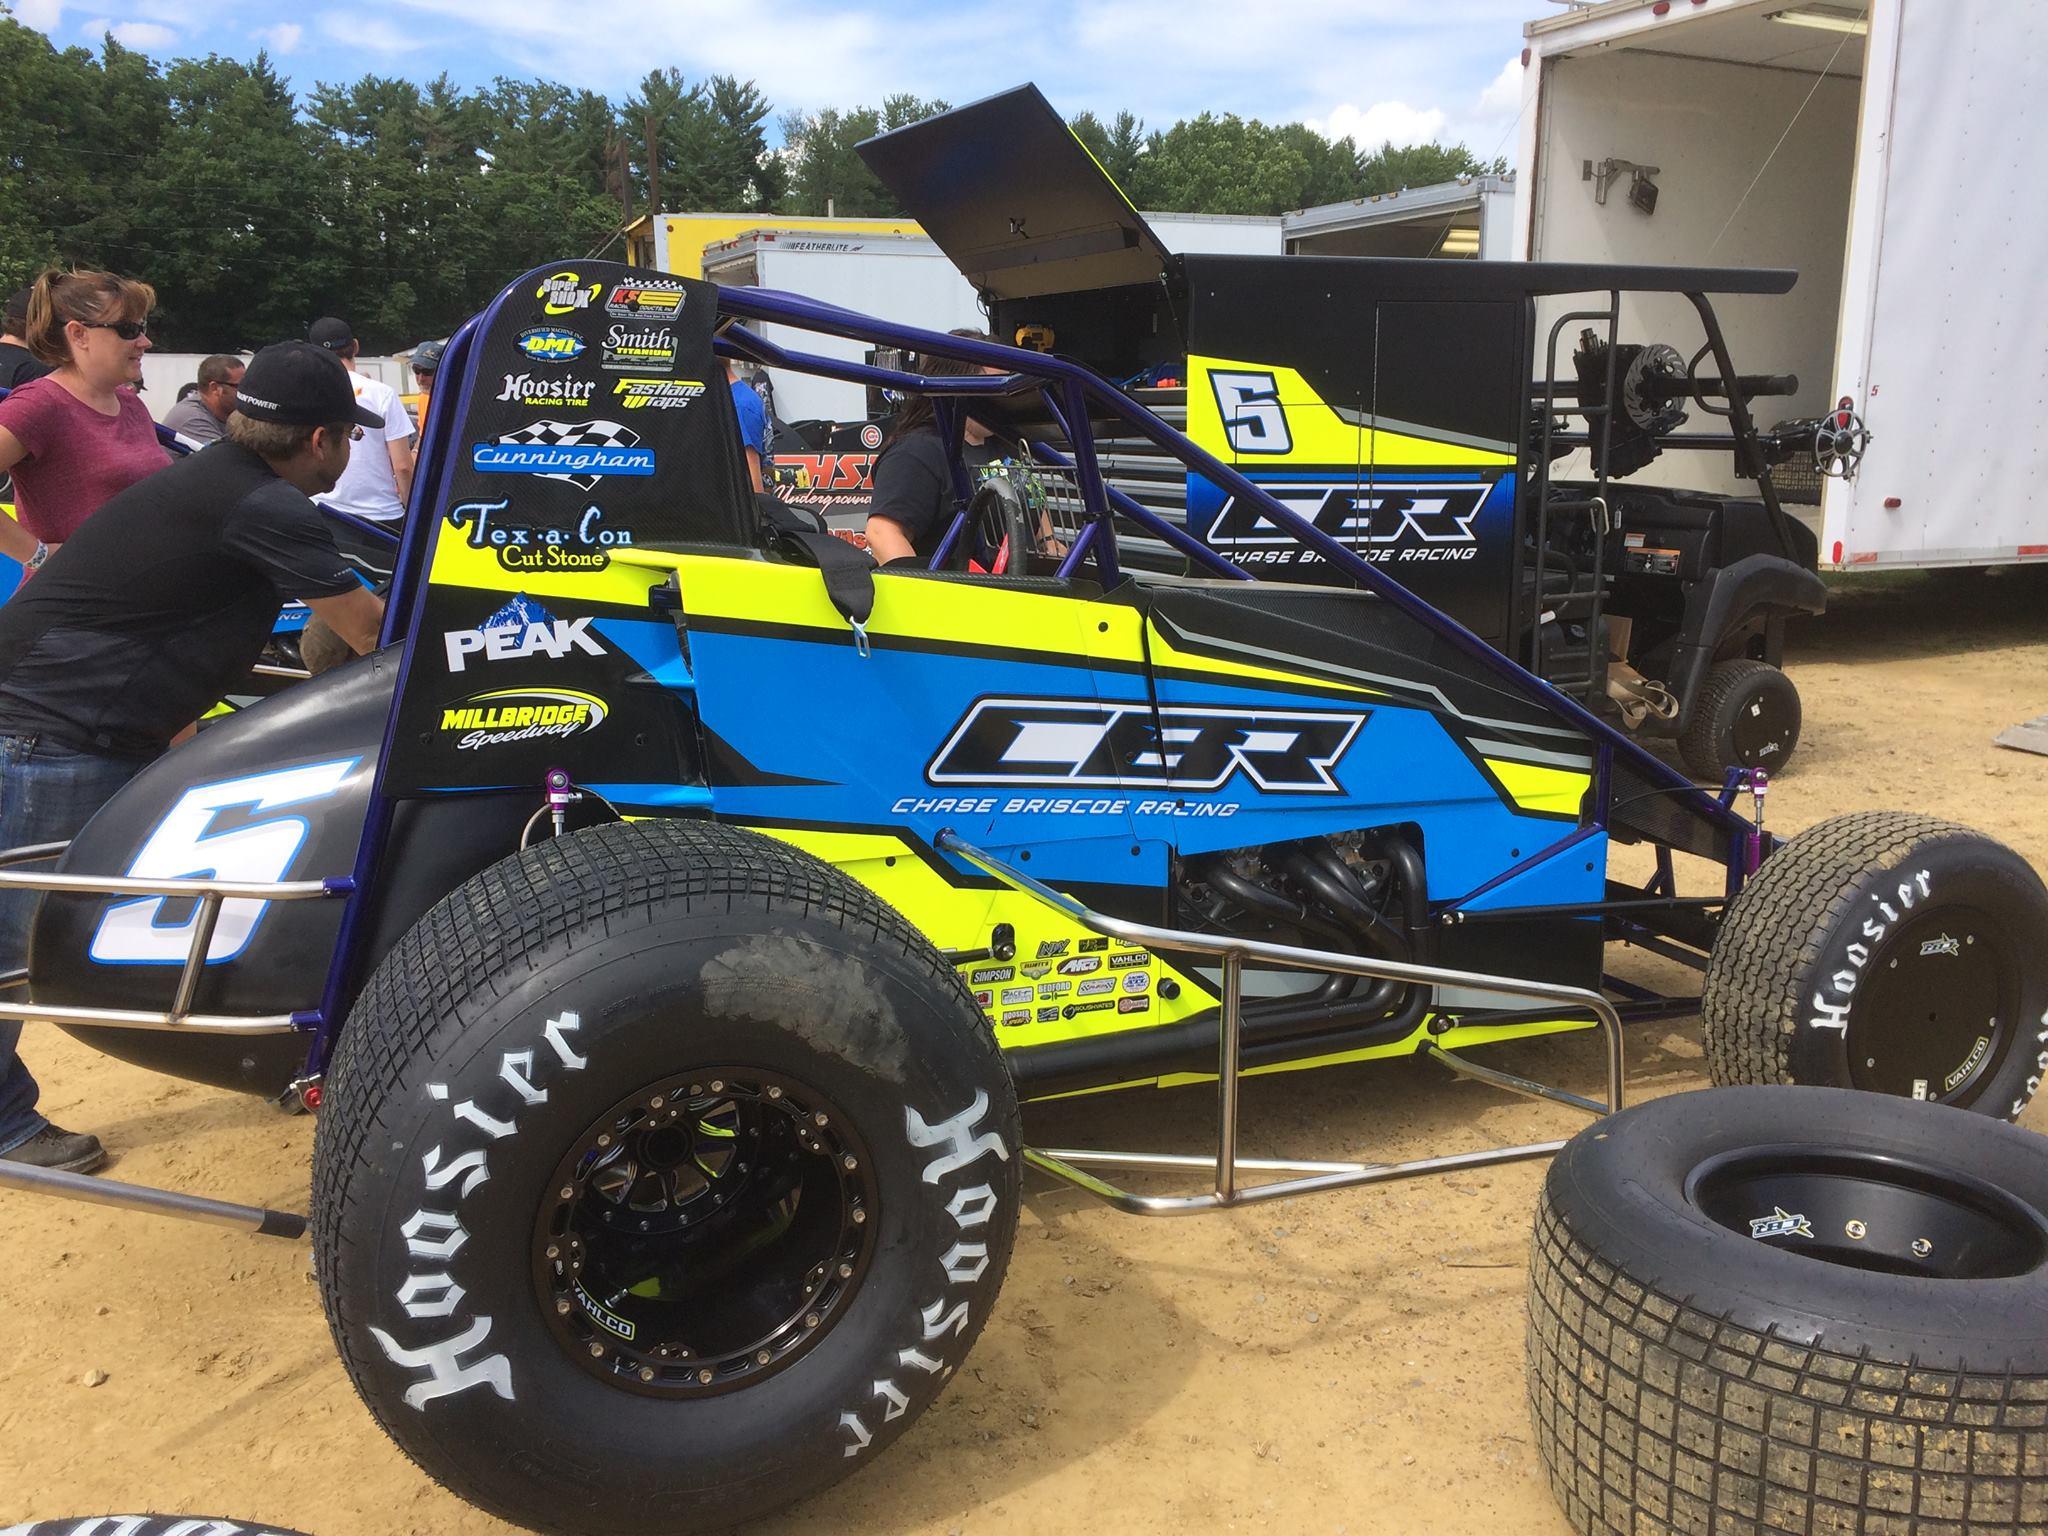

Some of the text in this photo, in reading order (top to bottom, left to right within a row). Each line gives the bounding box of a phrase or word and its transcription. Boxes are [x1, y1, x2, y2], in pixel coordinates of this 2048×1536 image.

[794, 242, 848, 252] FEATHERLITE
[550, 289, 592, 308] SHOX
[526, 336, 576, 353] DMI
[601, 324, 671, 349] Smith
[616, 347, 673, 357] TITANIUM
[496, 373, 597, 400] Hoosier
[612, 378, 706, 397] Fastlane
[525, 397, 589, 407] RACING TIRE
[621, 395, 691, 410] Wraps
[1207, 369, 1293, 454] 5
[473, 448, 655, 470] Cunningham
[1206, 483, 1494, 545] CBR
[502, 545, 605, 567] Cut Stone
[1398, 547, 1477, 562] RACING
[444, 616, 608, 673] PEAK
[441, 704, 591, 730] MILLBRIDGE
[457, 721, 581, 750] Speedway
[924, 694, 1373, 797] CBR
[890, 798, 1240, 817] CHASE BRISCOE RACING
[88, 756, 363, 966] 5
[1059, 957, 1100, 973] AFCO
[1111, 954, 1148, 964] VAHLCO
[1809, 868, 1931, 1040] Hoosier
[974, 967, 1012, 983] SIMPSON
[1038, 980, 1071, 993] BEDFORD
[1948, 1040, 1986, 1086] VAHLCO
[1912, 1080, 1927, 1101] 5
[368, 1009, 588, 1412] Hoosier
[837, 1087, 1011, 1458] Hoosier
